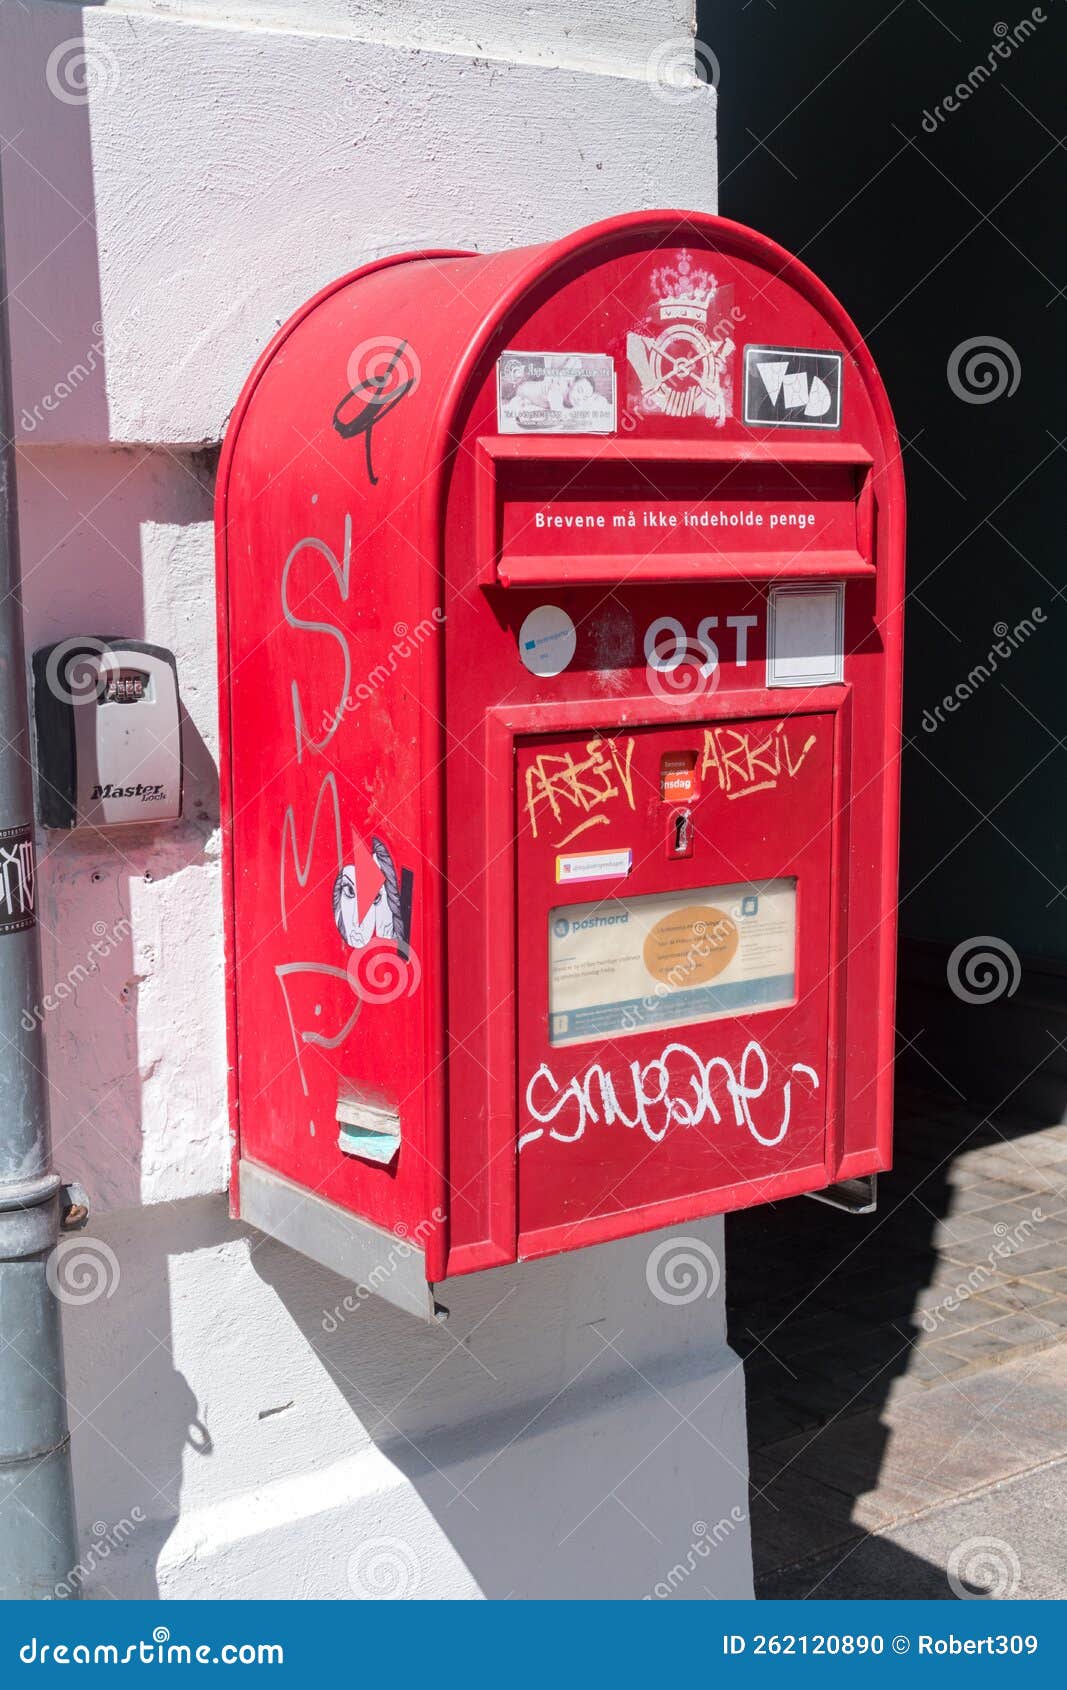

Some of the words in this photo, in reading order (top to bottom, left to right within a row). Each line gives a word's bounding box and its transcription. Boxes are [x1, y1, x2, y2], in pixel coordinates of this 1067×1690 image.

[534, 512, 606, 528] Brevene
[612, 510, 637, 527] må
[643, 511, 678, 527] ikke
[684, 510, 764, 527] indeholde
[769, 512, 817, 529] penge
[700, 722, 817, 792] ARKIV
[90, 783, 164, 800] Master
[141, 792, 167, 802] Lock
[572, 911, 629, 934] postnord
